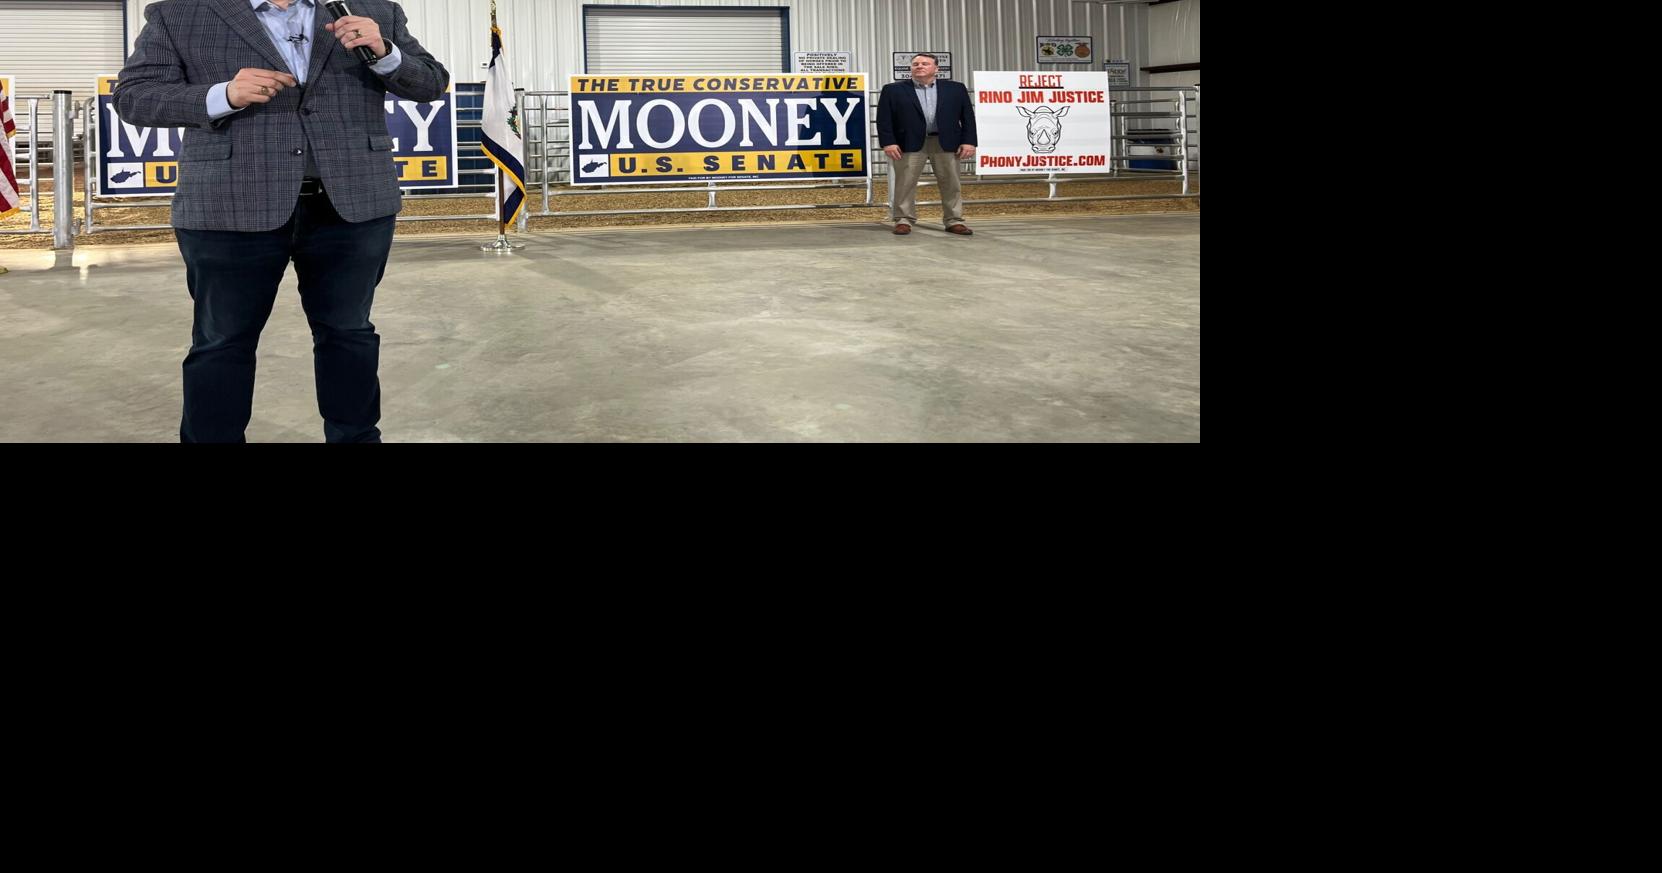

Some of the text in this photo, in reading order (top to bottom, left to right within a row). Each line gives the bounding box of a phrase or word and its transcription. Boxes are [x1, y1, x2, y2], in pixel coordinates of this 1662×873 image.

[578, 77, 858, 92] THE TRUE CONSERVATIVE
[1019, 75, 1062, 87] REJECT
[979, 91, 1104, 103] RINO JIM JUSTICE
[578, 98, 860, 149] MOONEY
[618, 153, 855, 173] U.S. SENATE
